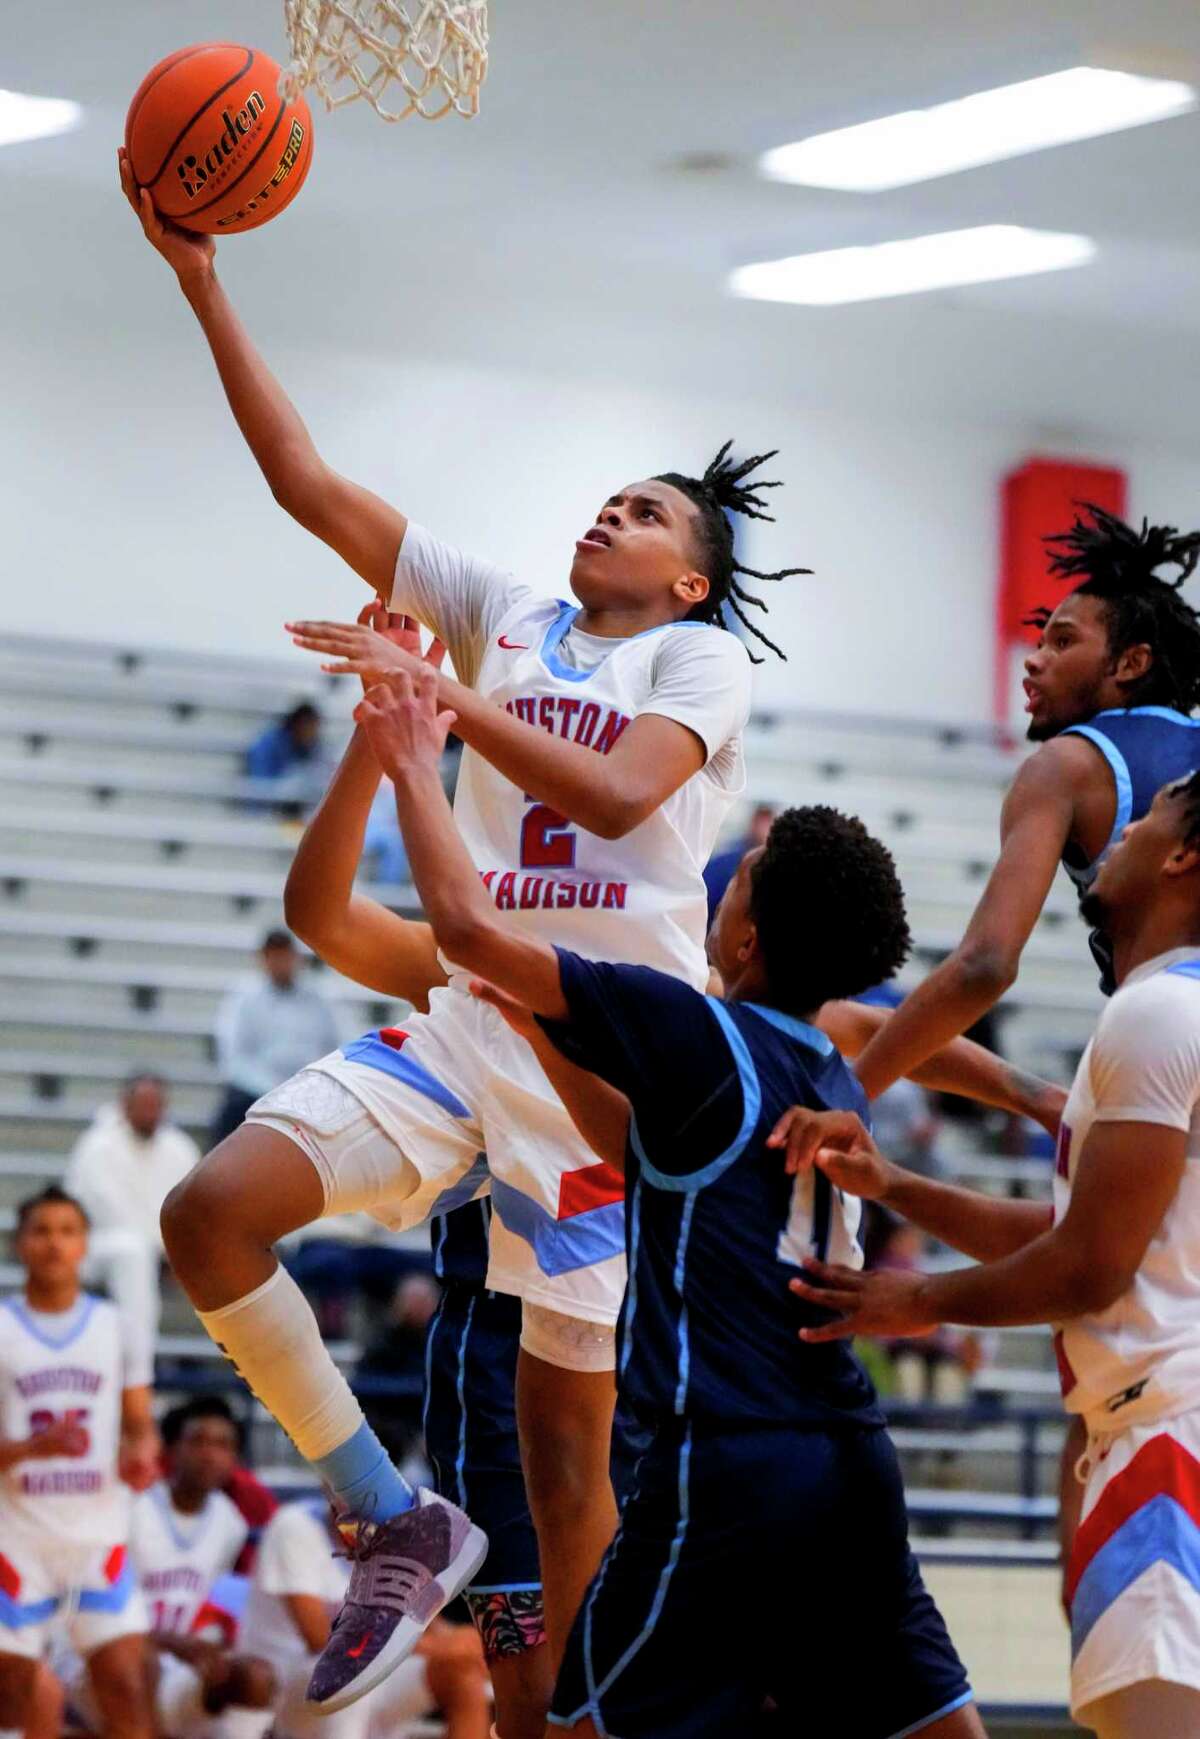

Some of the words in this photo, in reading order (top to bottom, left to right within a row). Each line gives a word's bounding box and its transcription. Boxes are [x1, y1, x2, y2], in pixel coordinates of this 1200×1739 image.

[177, 91, 266, 200] Baden
[506, 696, 631, 755] USTON
[520, 794, 577, 869] 2
